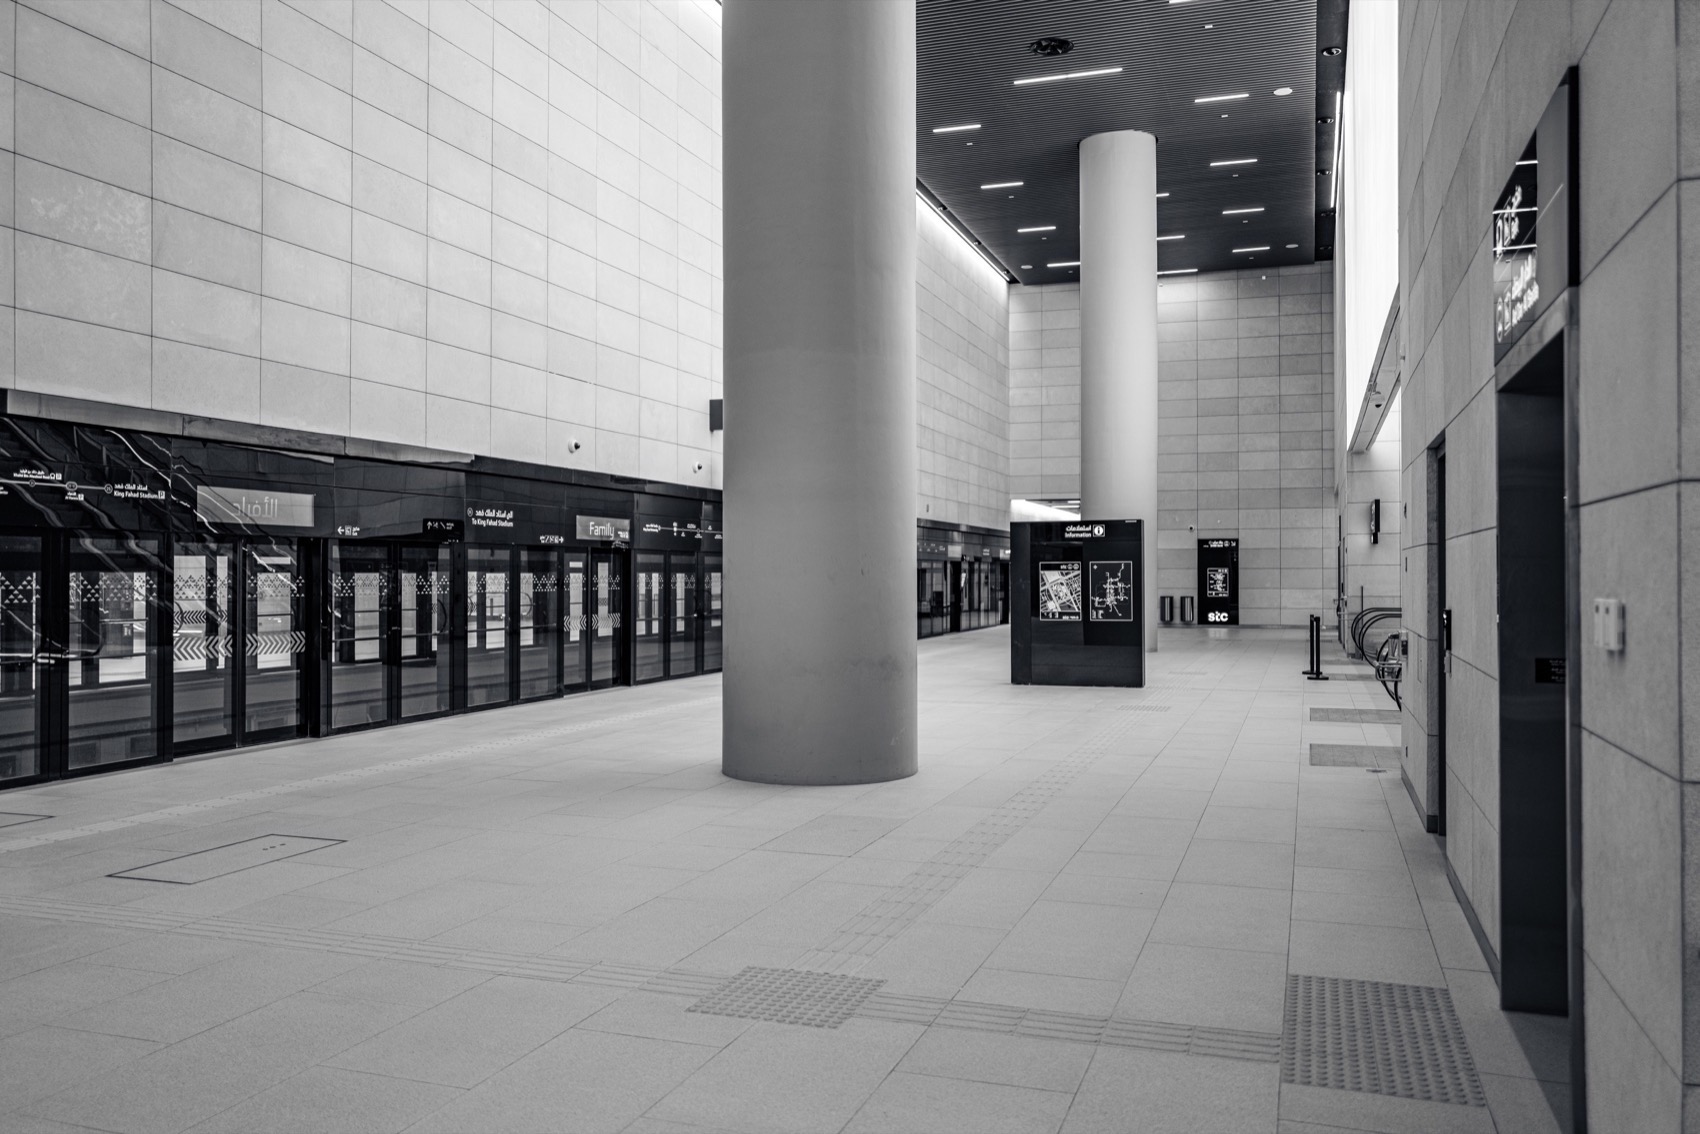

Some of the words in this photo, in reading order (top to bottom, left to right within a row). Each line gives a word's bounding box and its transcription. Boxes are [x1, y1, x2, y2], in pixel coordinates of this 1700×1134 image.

[114, 490, 125, 498] King
[140, 491, 158, 499] Stadium
[233, 496, 277, 518] الأفراد
[472, 517, 477, 525] To
[477, 518, 486, 527] King
[487, 518, 497, 526] Fahad
[498, 519, 513, 527] Stadium
[590, 521, 614, 540] Family
[1208, 611, 1228, 622] stc
